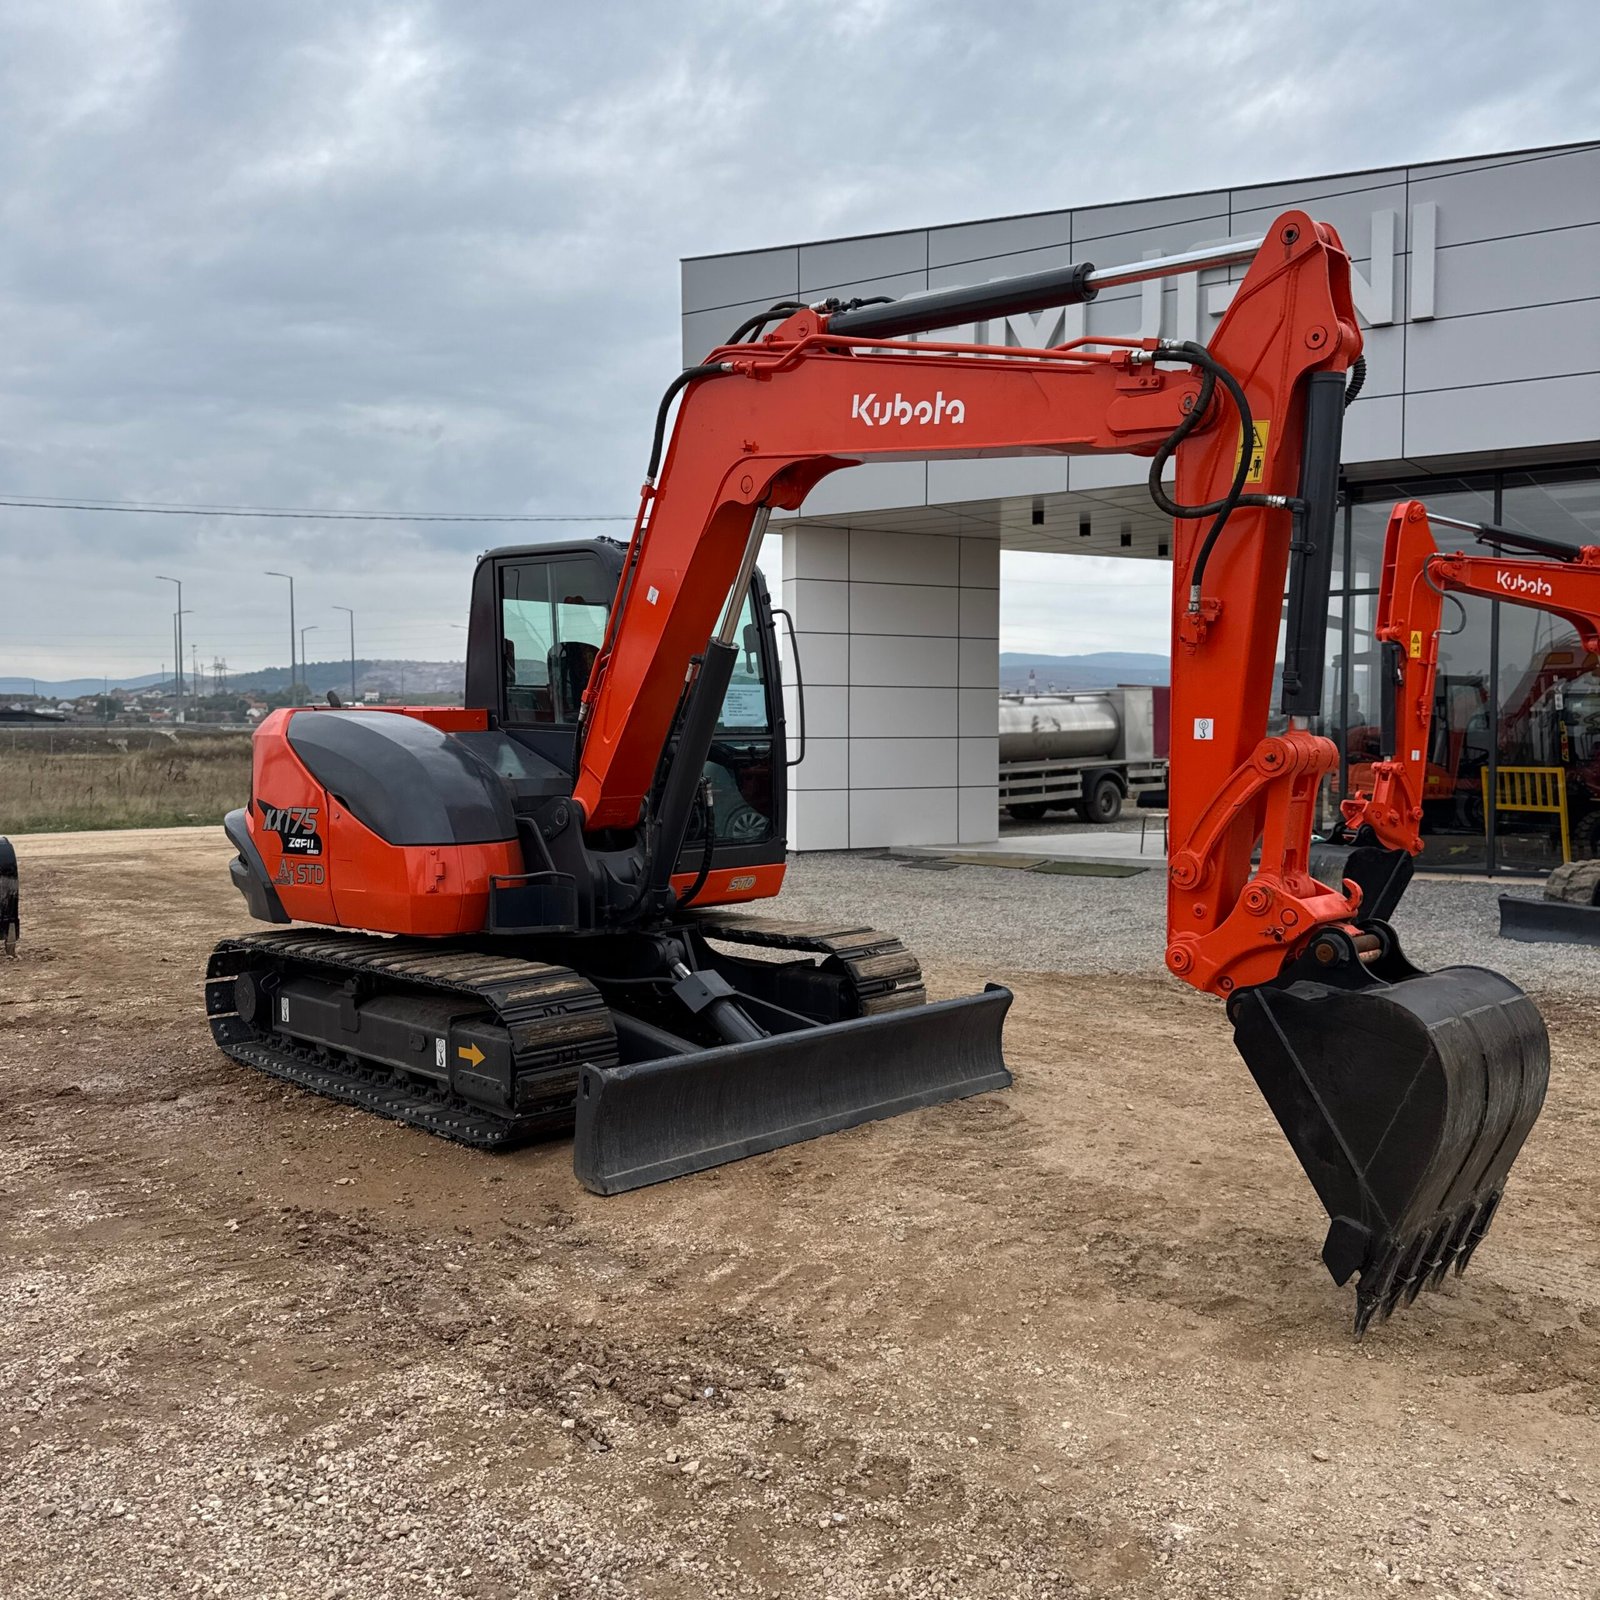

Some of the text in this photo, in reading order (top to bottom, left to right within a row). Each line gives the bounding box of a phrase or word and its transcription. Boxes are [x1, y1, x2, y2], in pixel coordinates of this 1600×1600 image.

[851, 391, 965, 426] Kubota
[1496, 570, 1552, 597] Kubota
[262, 806, 319, 836] KX175
[297, 864, 325, 885] STD
